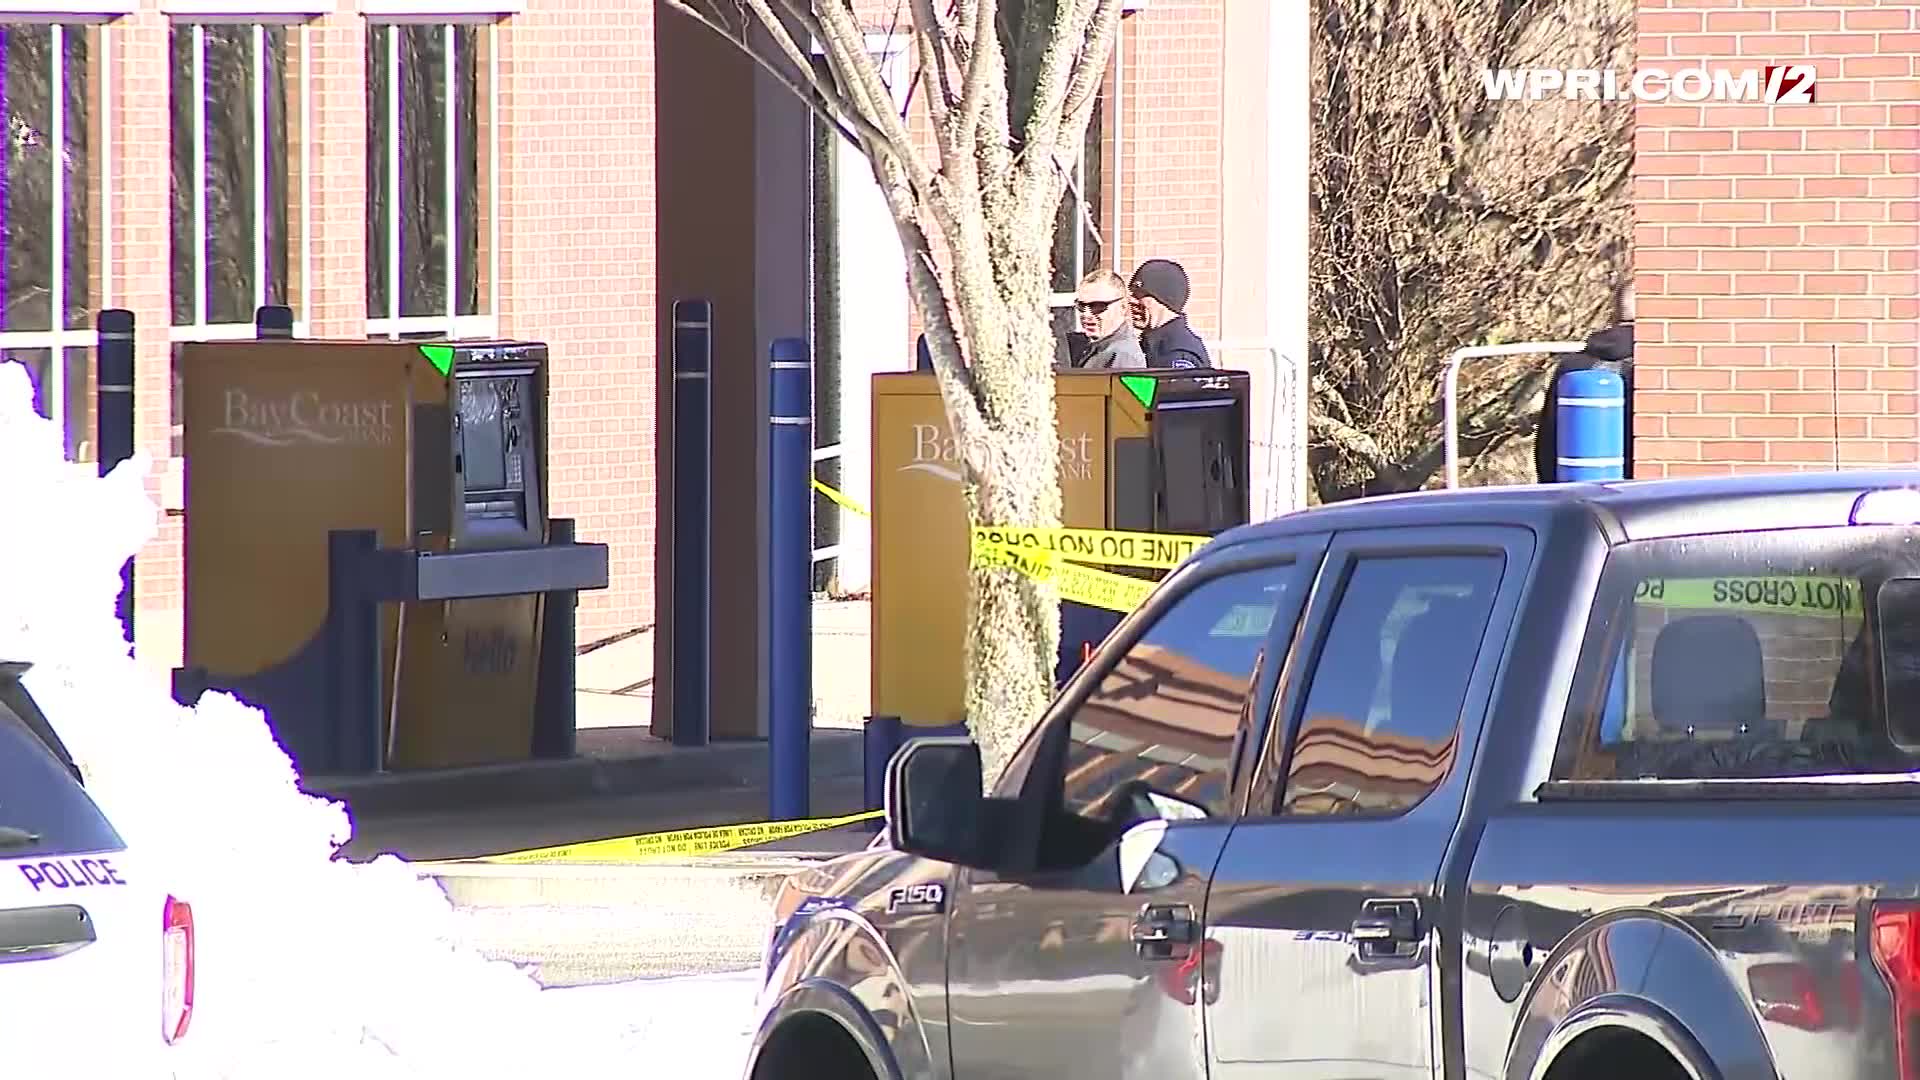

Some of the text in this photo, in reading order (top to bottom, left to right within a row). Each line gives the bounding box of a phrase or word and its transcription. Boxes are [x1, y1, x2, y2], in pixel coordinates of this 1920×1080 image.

[225, 389, 392, 431] BayCoast
[1058, 463, 1093, 480] ANK
[1100, 536, 1134, 560] DO
[1141, 538, 1193, 564] LINE
[1713, 580, 1796, 606] CROSS
[17, 859, 127, 891] POLICE
[1712, 903, 1848, 930] SPORT
